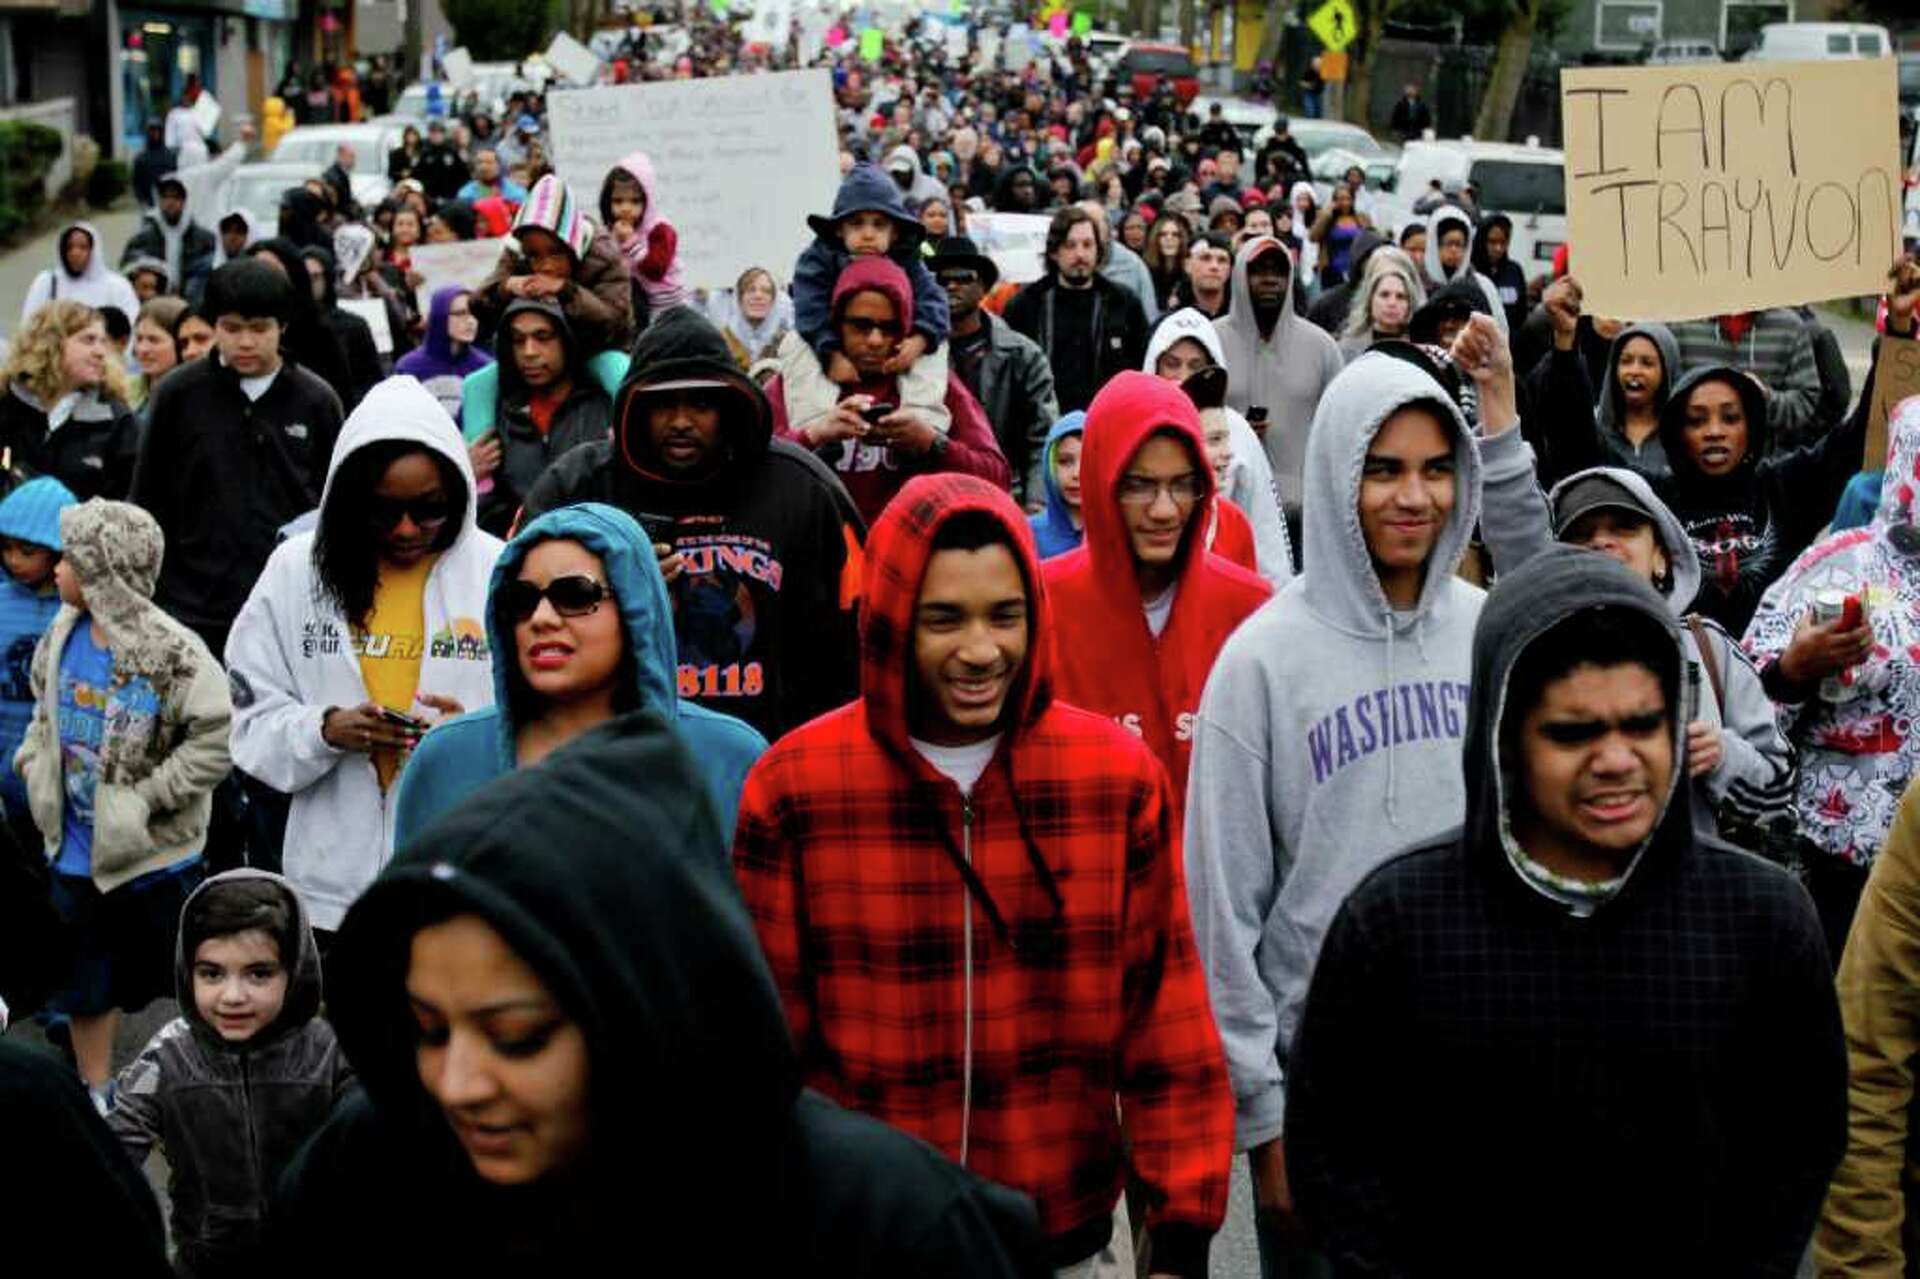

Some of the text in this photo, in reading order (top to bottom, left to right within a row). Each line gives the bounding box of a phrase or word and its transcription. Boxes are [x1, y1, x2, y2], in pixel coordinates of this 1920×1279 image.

[1566, 77, 1797, 178] I AM
[1113, 713, 1143, 737] S
